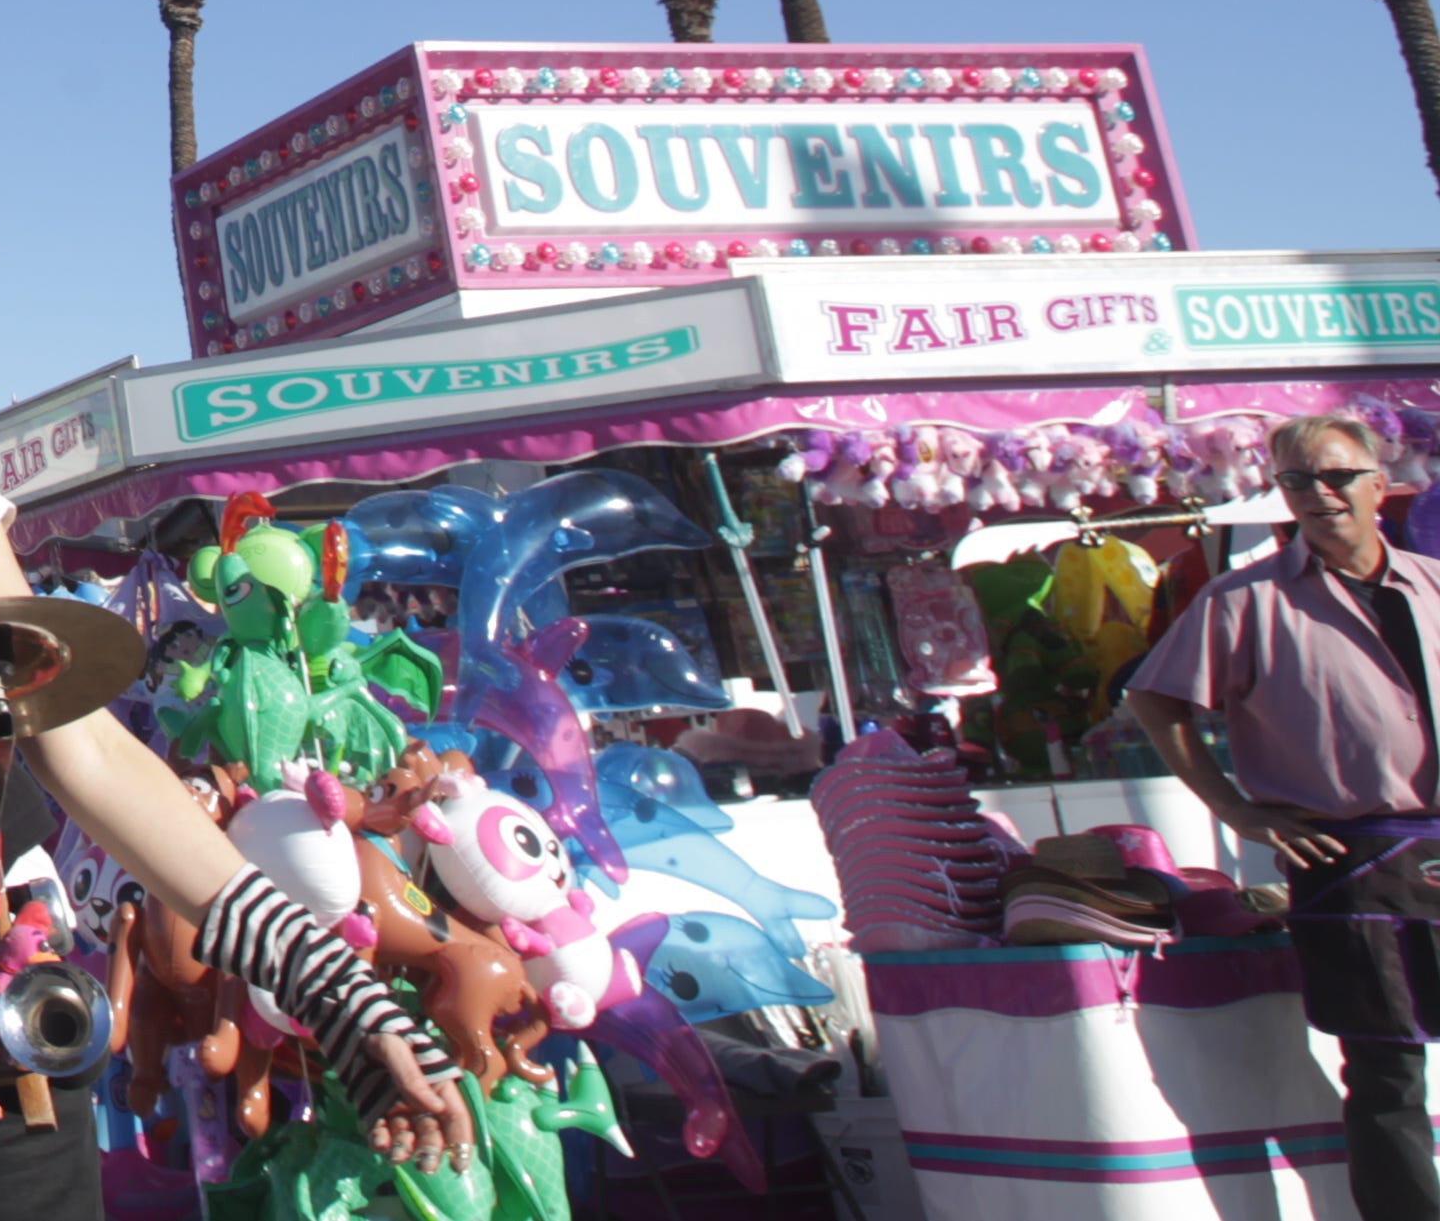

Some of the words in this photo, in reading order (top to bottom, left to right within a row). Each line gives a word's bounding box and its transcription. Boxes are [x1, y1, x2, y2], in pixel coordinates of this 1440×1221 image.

[496, 122, 1104, 213] SOUVENIRS
[224, 139, 411, 305] SOUVENIRS
[823, 301, 1026, 356] FAIR
[1044, 291, 1162, 336] GIFTS
[1188, 292, 1440, 340] SOUVENIRS
[208, 333, 673, 428] SOUVENIRS
[51, 412, 96, 459] GIFTS
